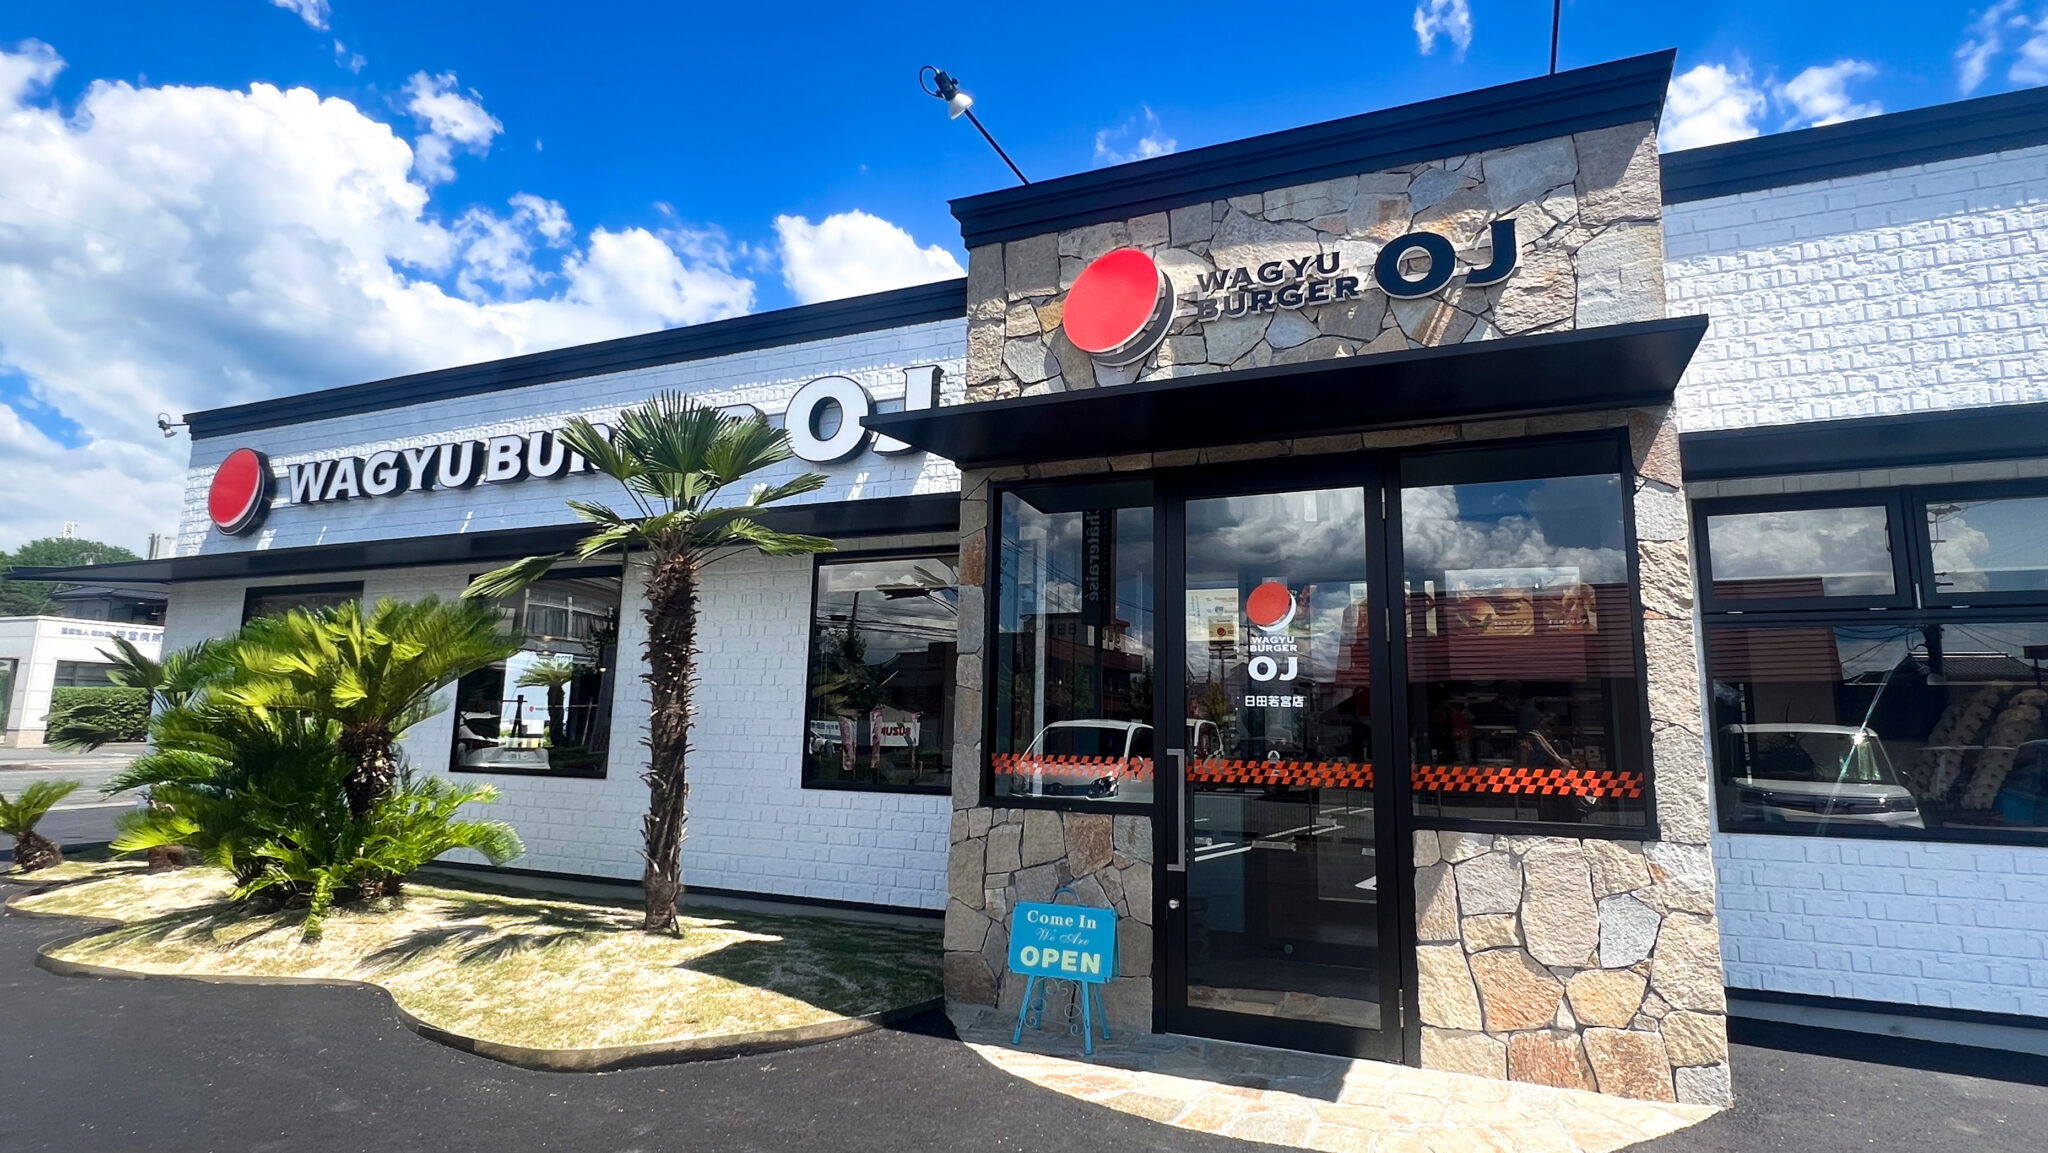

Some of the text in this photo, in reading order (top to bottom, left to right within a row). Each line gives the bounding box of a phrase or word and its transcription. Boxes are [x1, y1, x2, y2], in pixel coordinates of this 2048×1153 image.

[1374, 218, 1518, 300] OJ
[1196, 251, 1342, 294] WAGYU
[1197, 277, 1360, 322] BURGER
[288, 440, 480, 505] WAGYU
[1250, 636, 1295, 644] WAGYU
[1250, 644, 1298, 652] BURGER
[1248, 656, 1298, 682] OJ
[1245, 695, 1304, 708] 日田若宮店
[1027, 909, 1097, 930] Come In
[1036, 927, 1090, 946] We Are
[1020, 945, 1100, 974] OPEN
